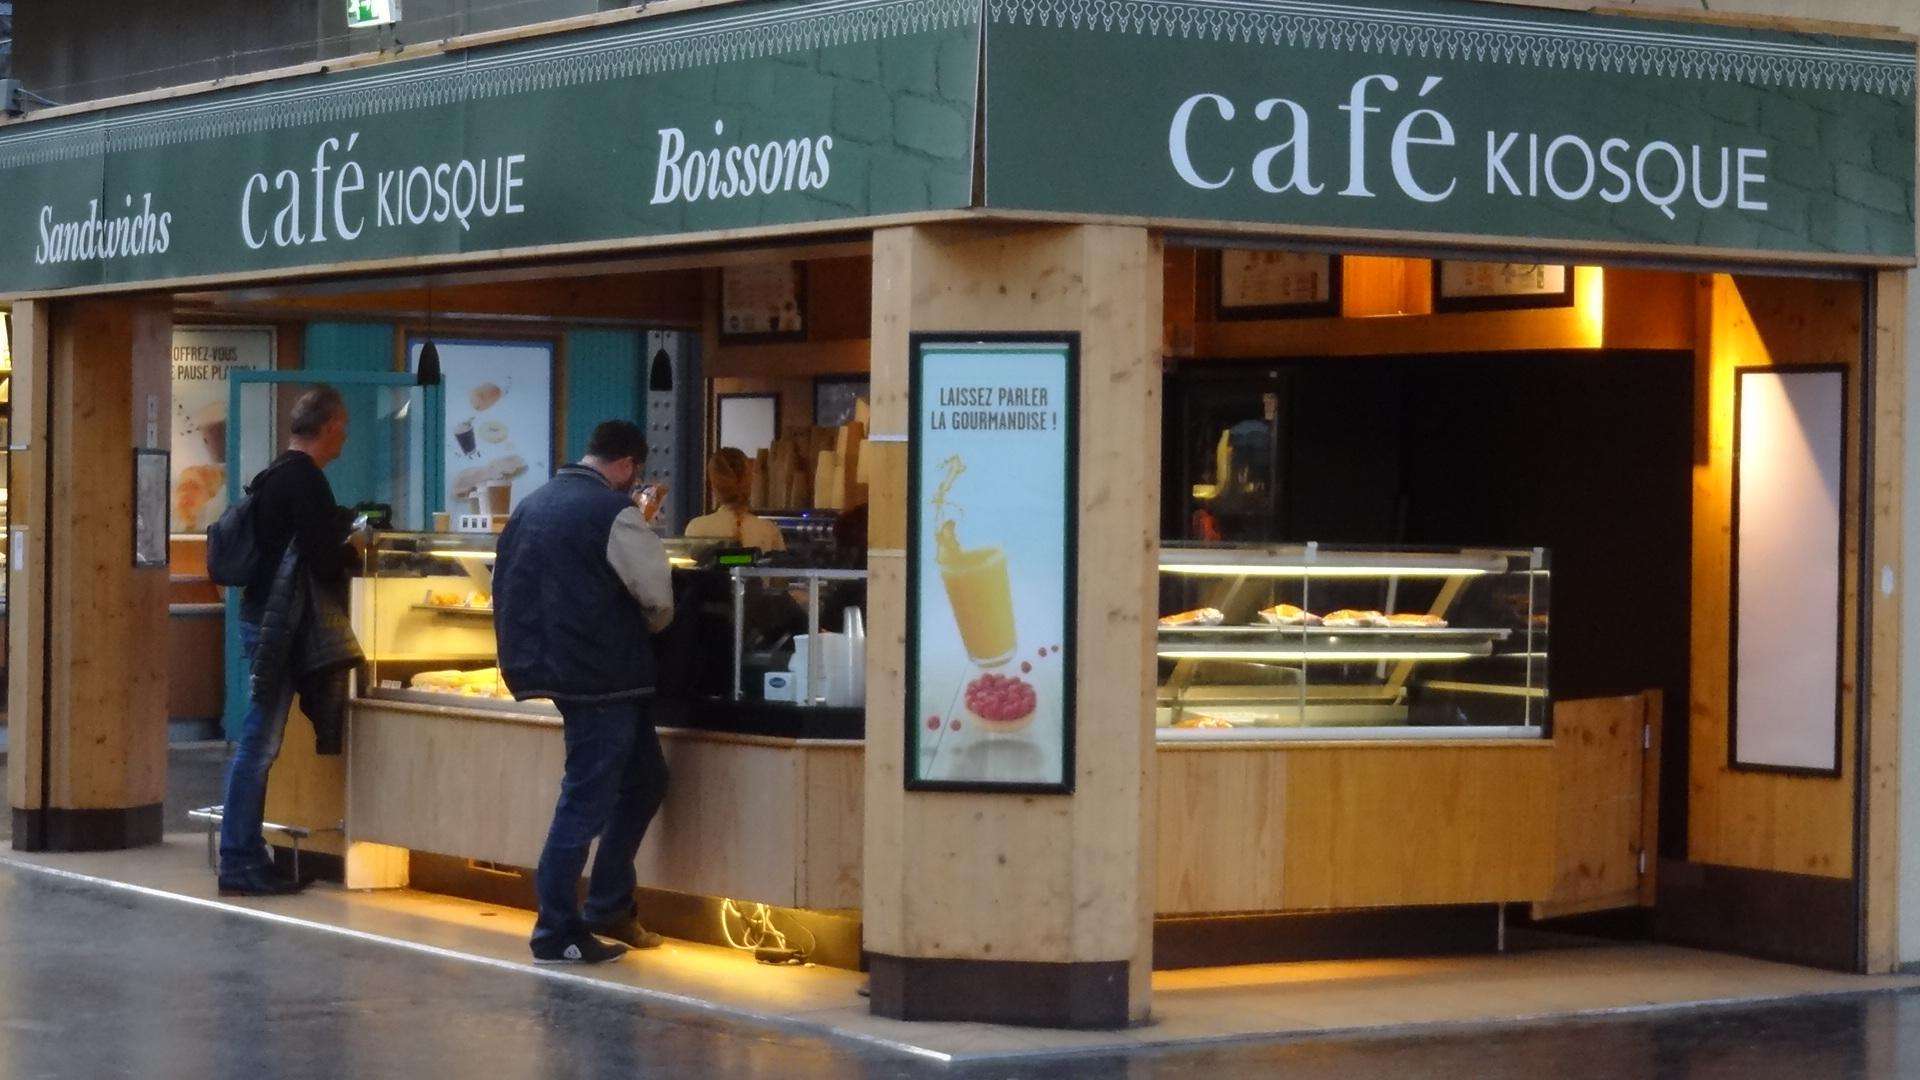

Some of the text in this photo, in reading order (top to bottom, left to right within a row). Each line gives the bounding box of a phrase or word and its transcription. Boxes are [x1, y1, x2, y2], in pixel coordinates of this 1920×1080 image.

[650, 119, 833, 205] Boissons
[1168, 74, 1768, 220] café KIOSQUE
[241, 132, 526, 249] café KIOSQUE
[35, 192, 172, 265] Sandwichs
[173, 346, 238, 361] OFFREZ-VOUS
[177, 365, 208, 380] PAUSE
[940, 387, 1048, 406] LAISSEZ PARLER
[931, 411, 946, 429] LA
[952, 411, 1047, 430] GOURMANDISE
